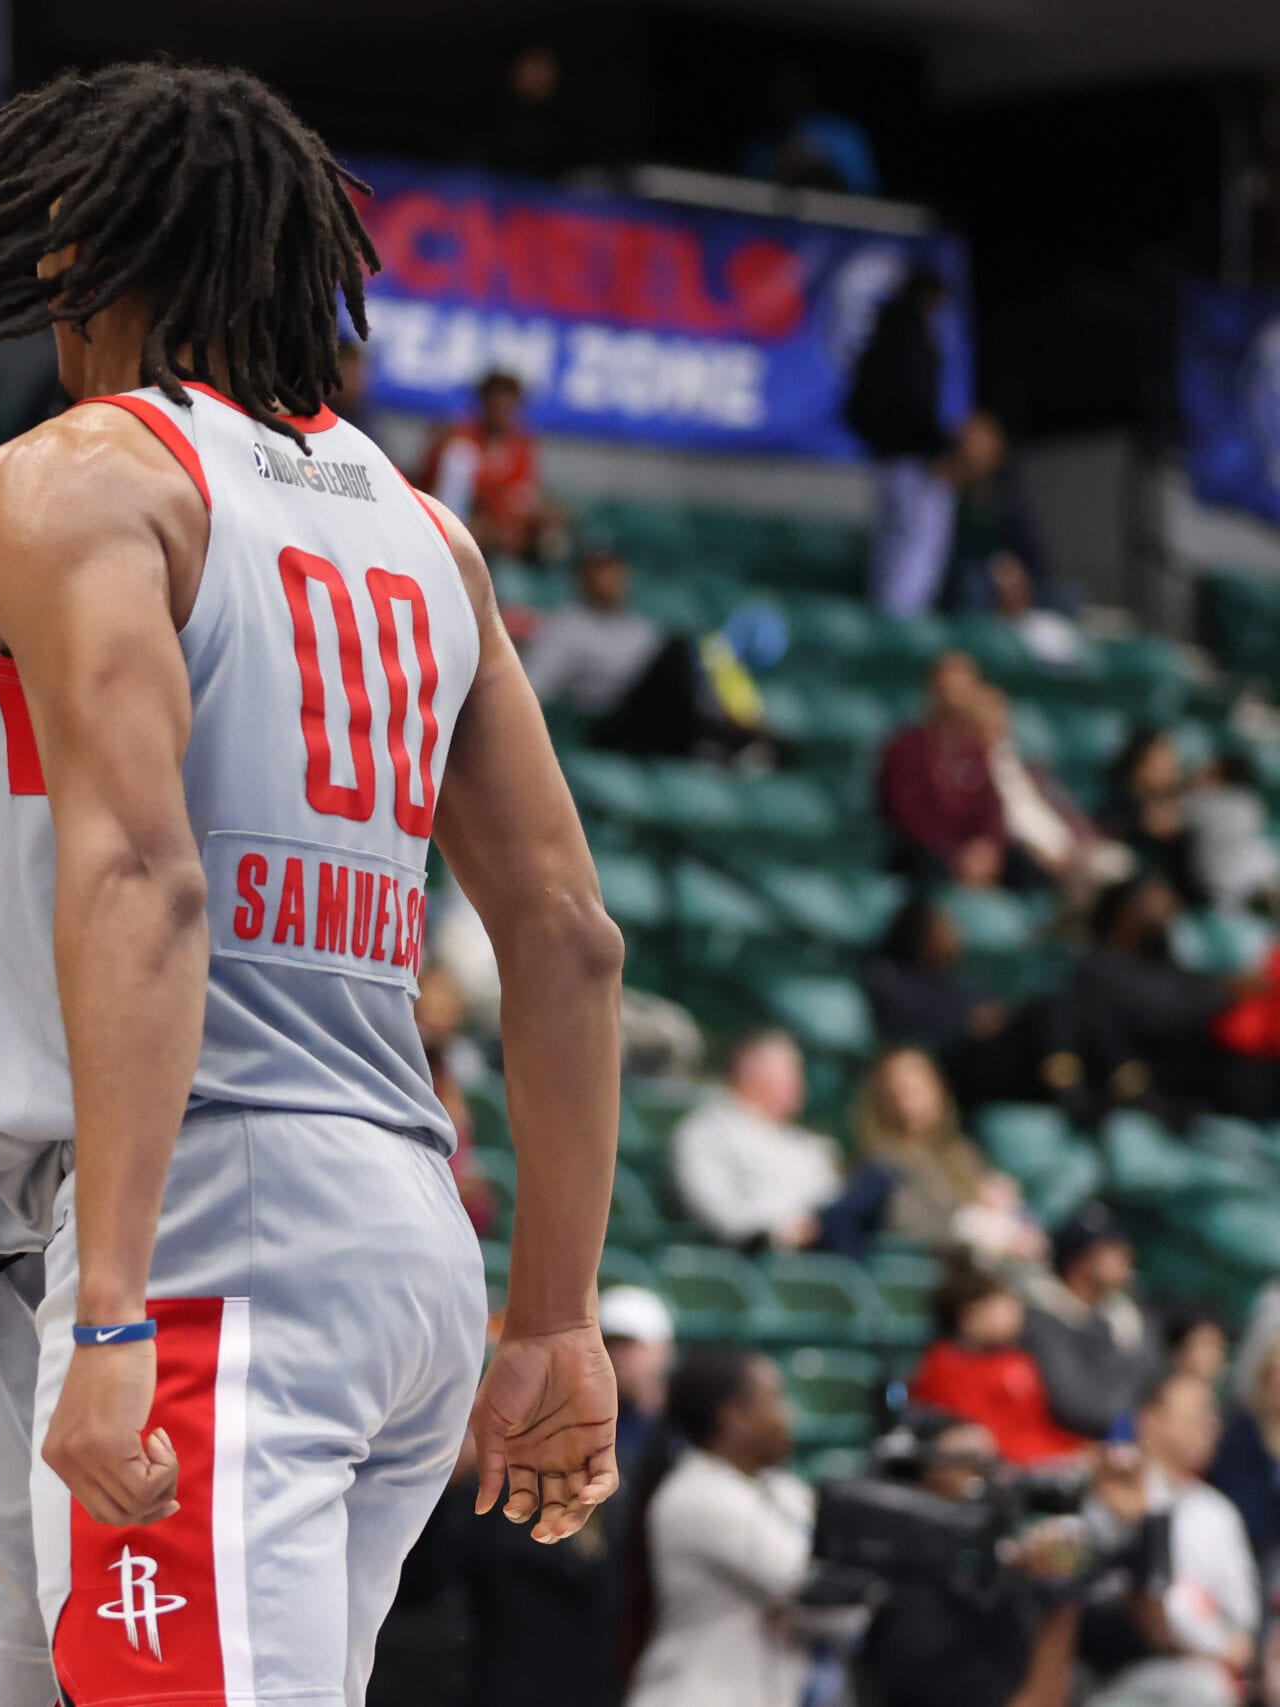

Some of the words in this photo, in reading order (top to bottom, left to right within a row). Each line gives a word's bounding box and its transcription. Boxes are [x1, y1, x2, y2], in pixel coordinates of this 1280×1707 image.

[263, 445, 305, 488] NBA
[315, 460, 377, 502] LEAGUE
[278, 545, 438, 839] 00
